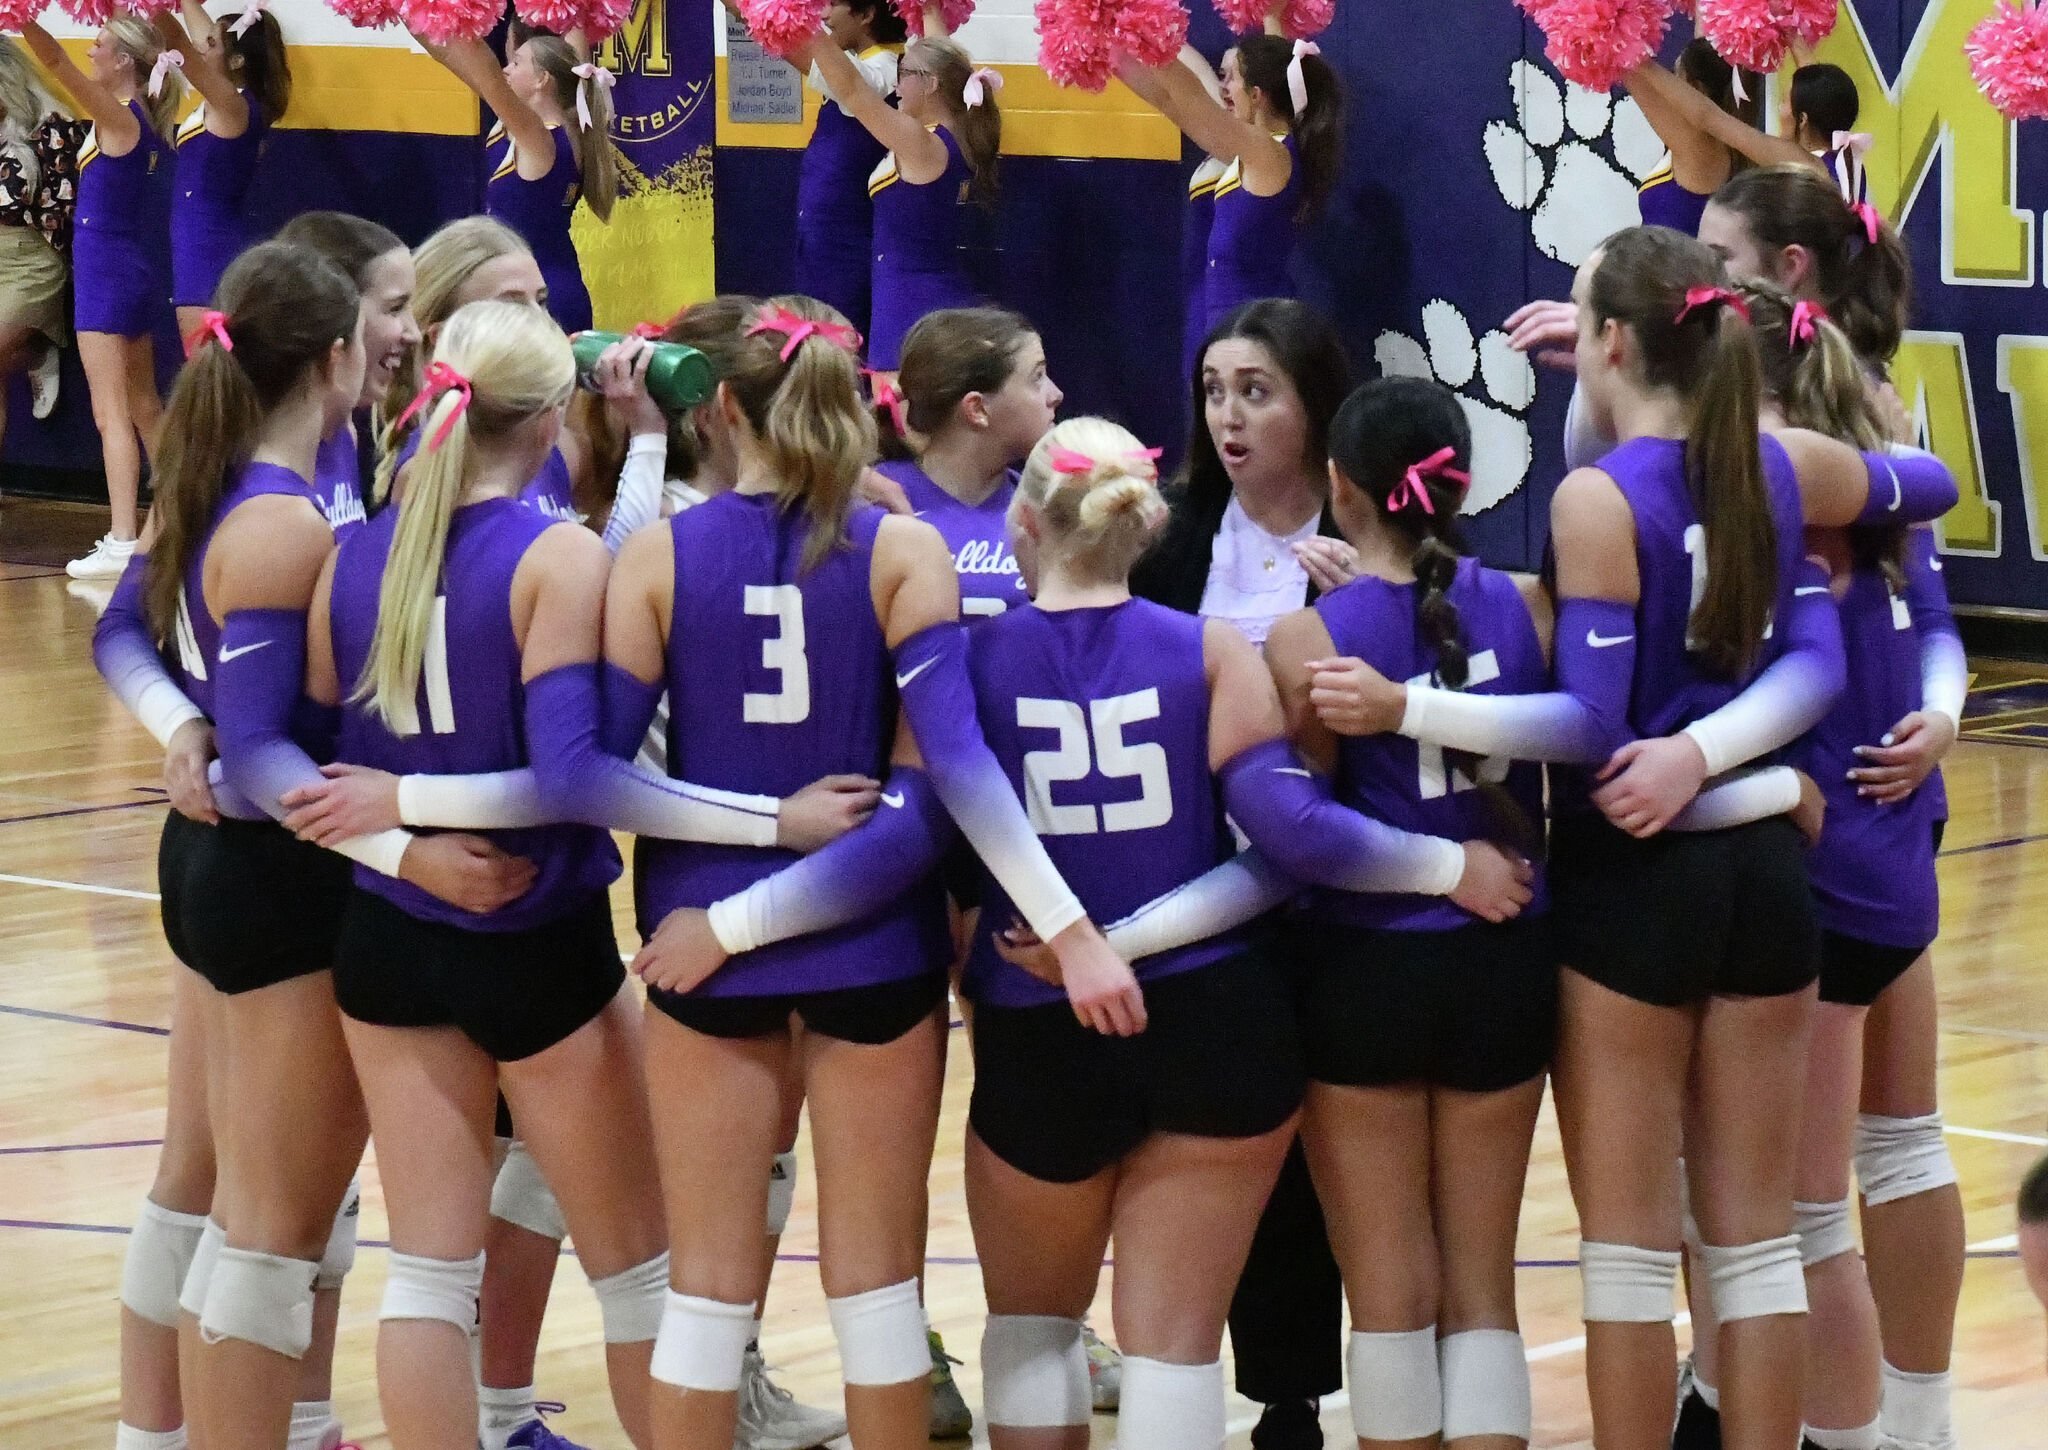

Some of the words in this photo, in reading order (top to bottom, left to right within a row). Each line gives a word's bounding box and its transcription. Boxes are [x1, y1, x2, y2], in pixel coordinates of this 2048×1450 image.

[621, 80, 702, 133] ETBALL
[743, 583, 811, 724] 3
[1015, 686, 1173, 836] 25
